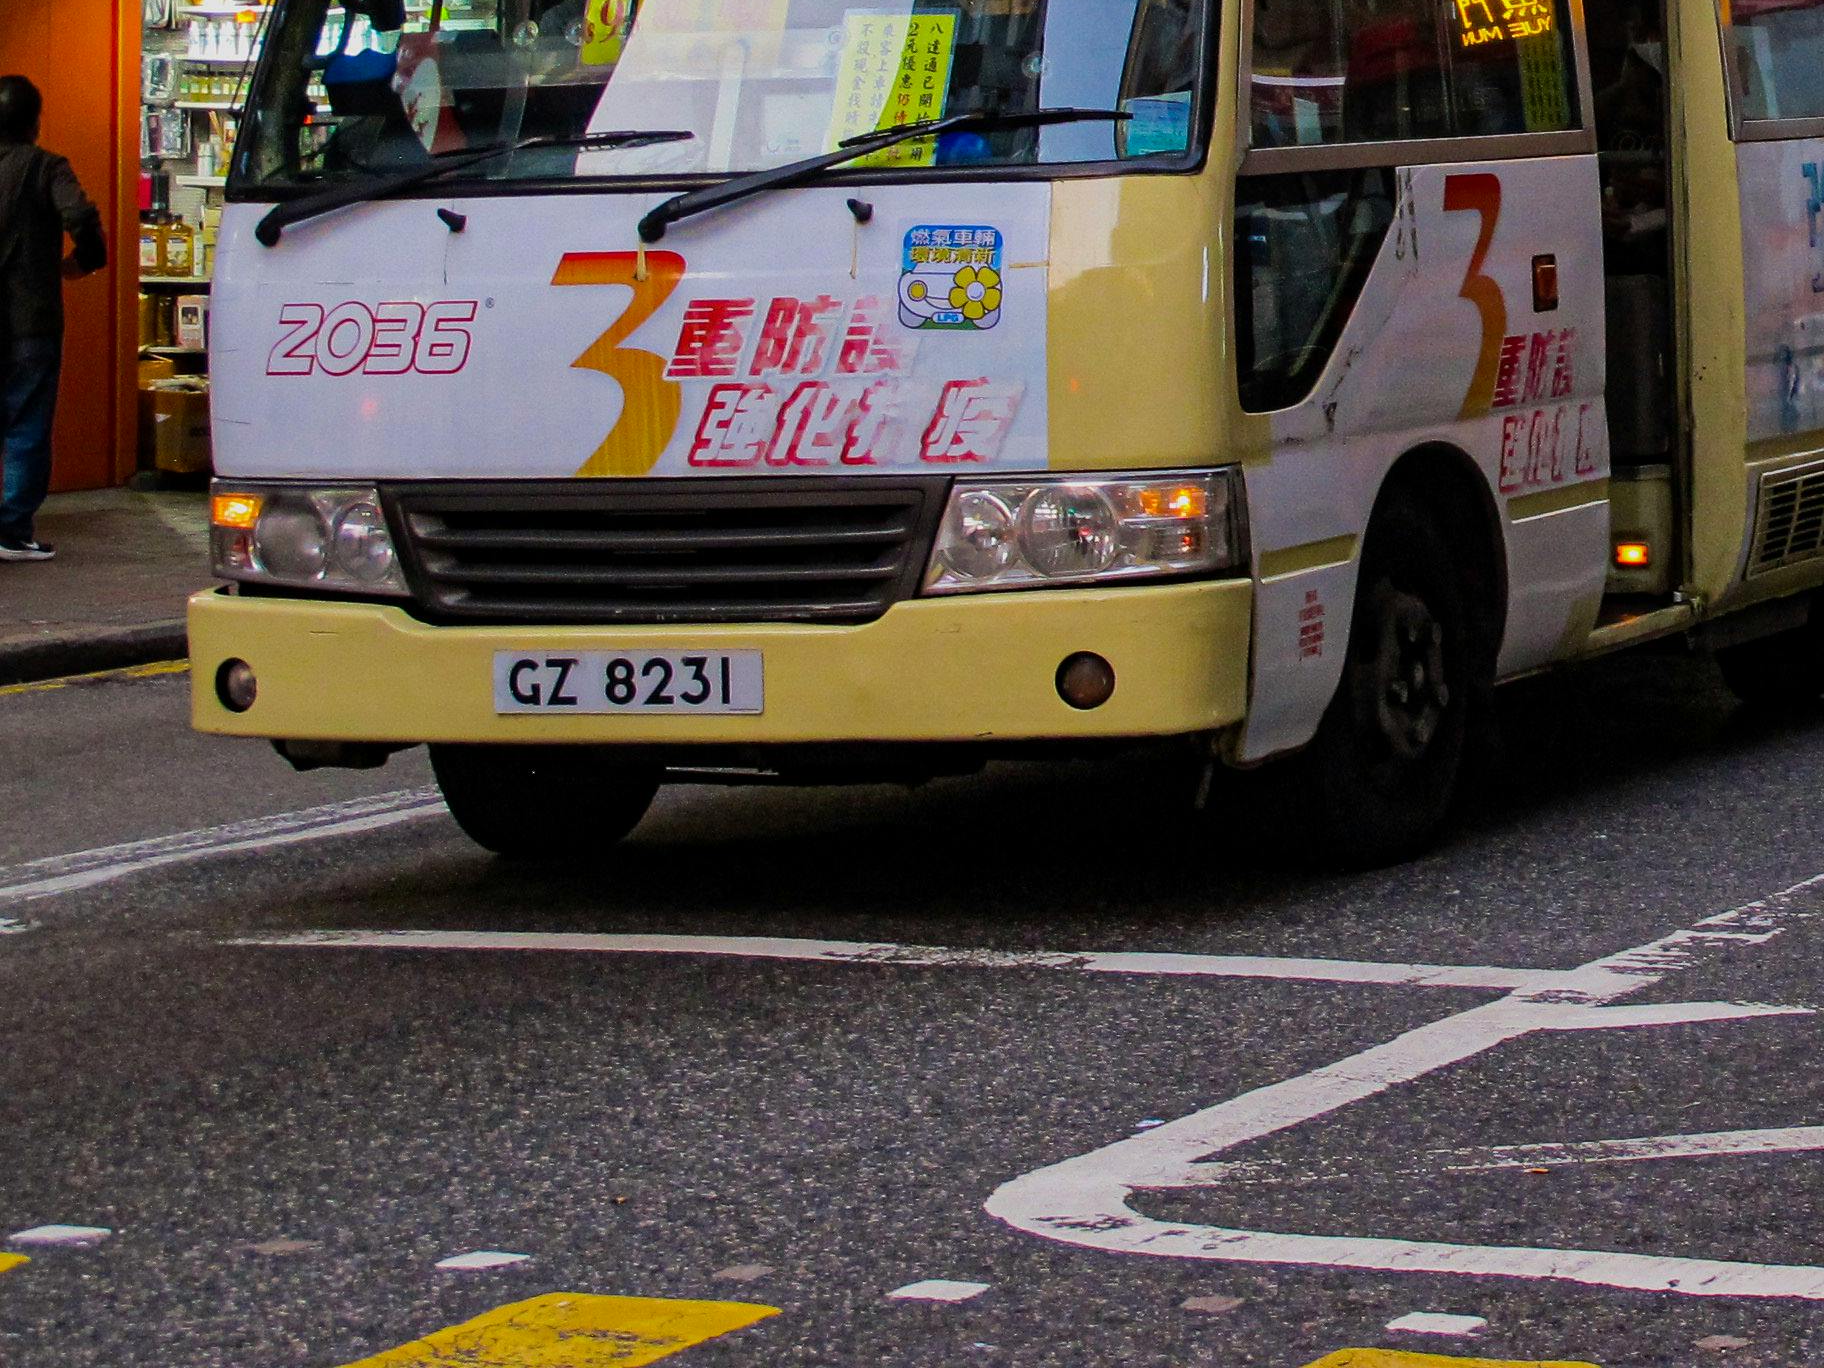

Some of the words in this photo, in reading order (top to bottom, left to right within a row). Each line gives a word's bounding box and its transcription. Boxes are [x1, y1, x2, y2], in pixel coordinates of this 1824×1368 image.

[266, 297, 479, 376] 2036
[550, 250, 687, 478] 3
[1443, 172, 1508, 423] 3
[507, 659, 579, 705] GZ
[605, 656, 733, 707] 8231
